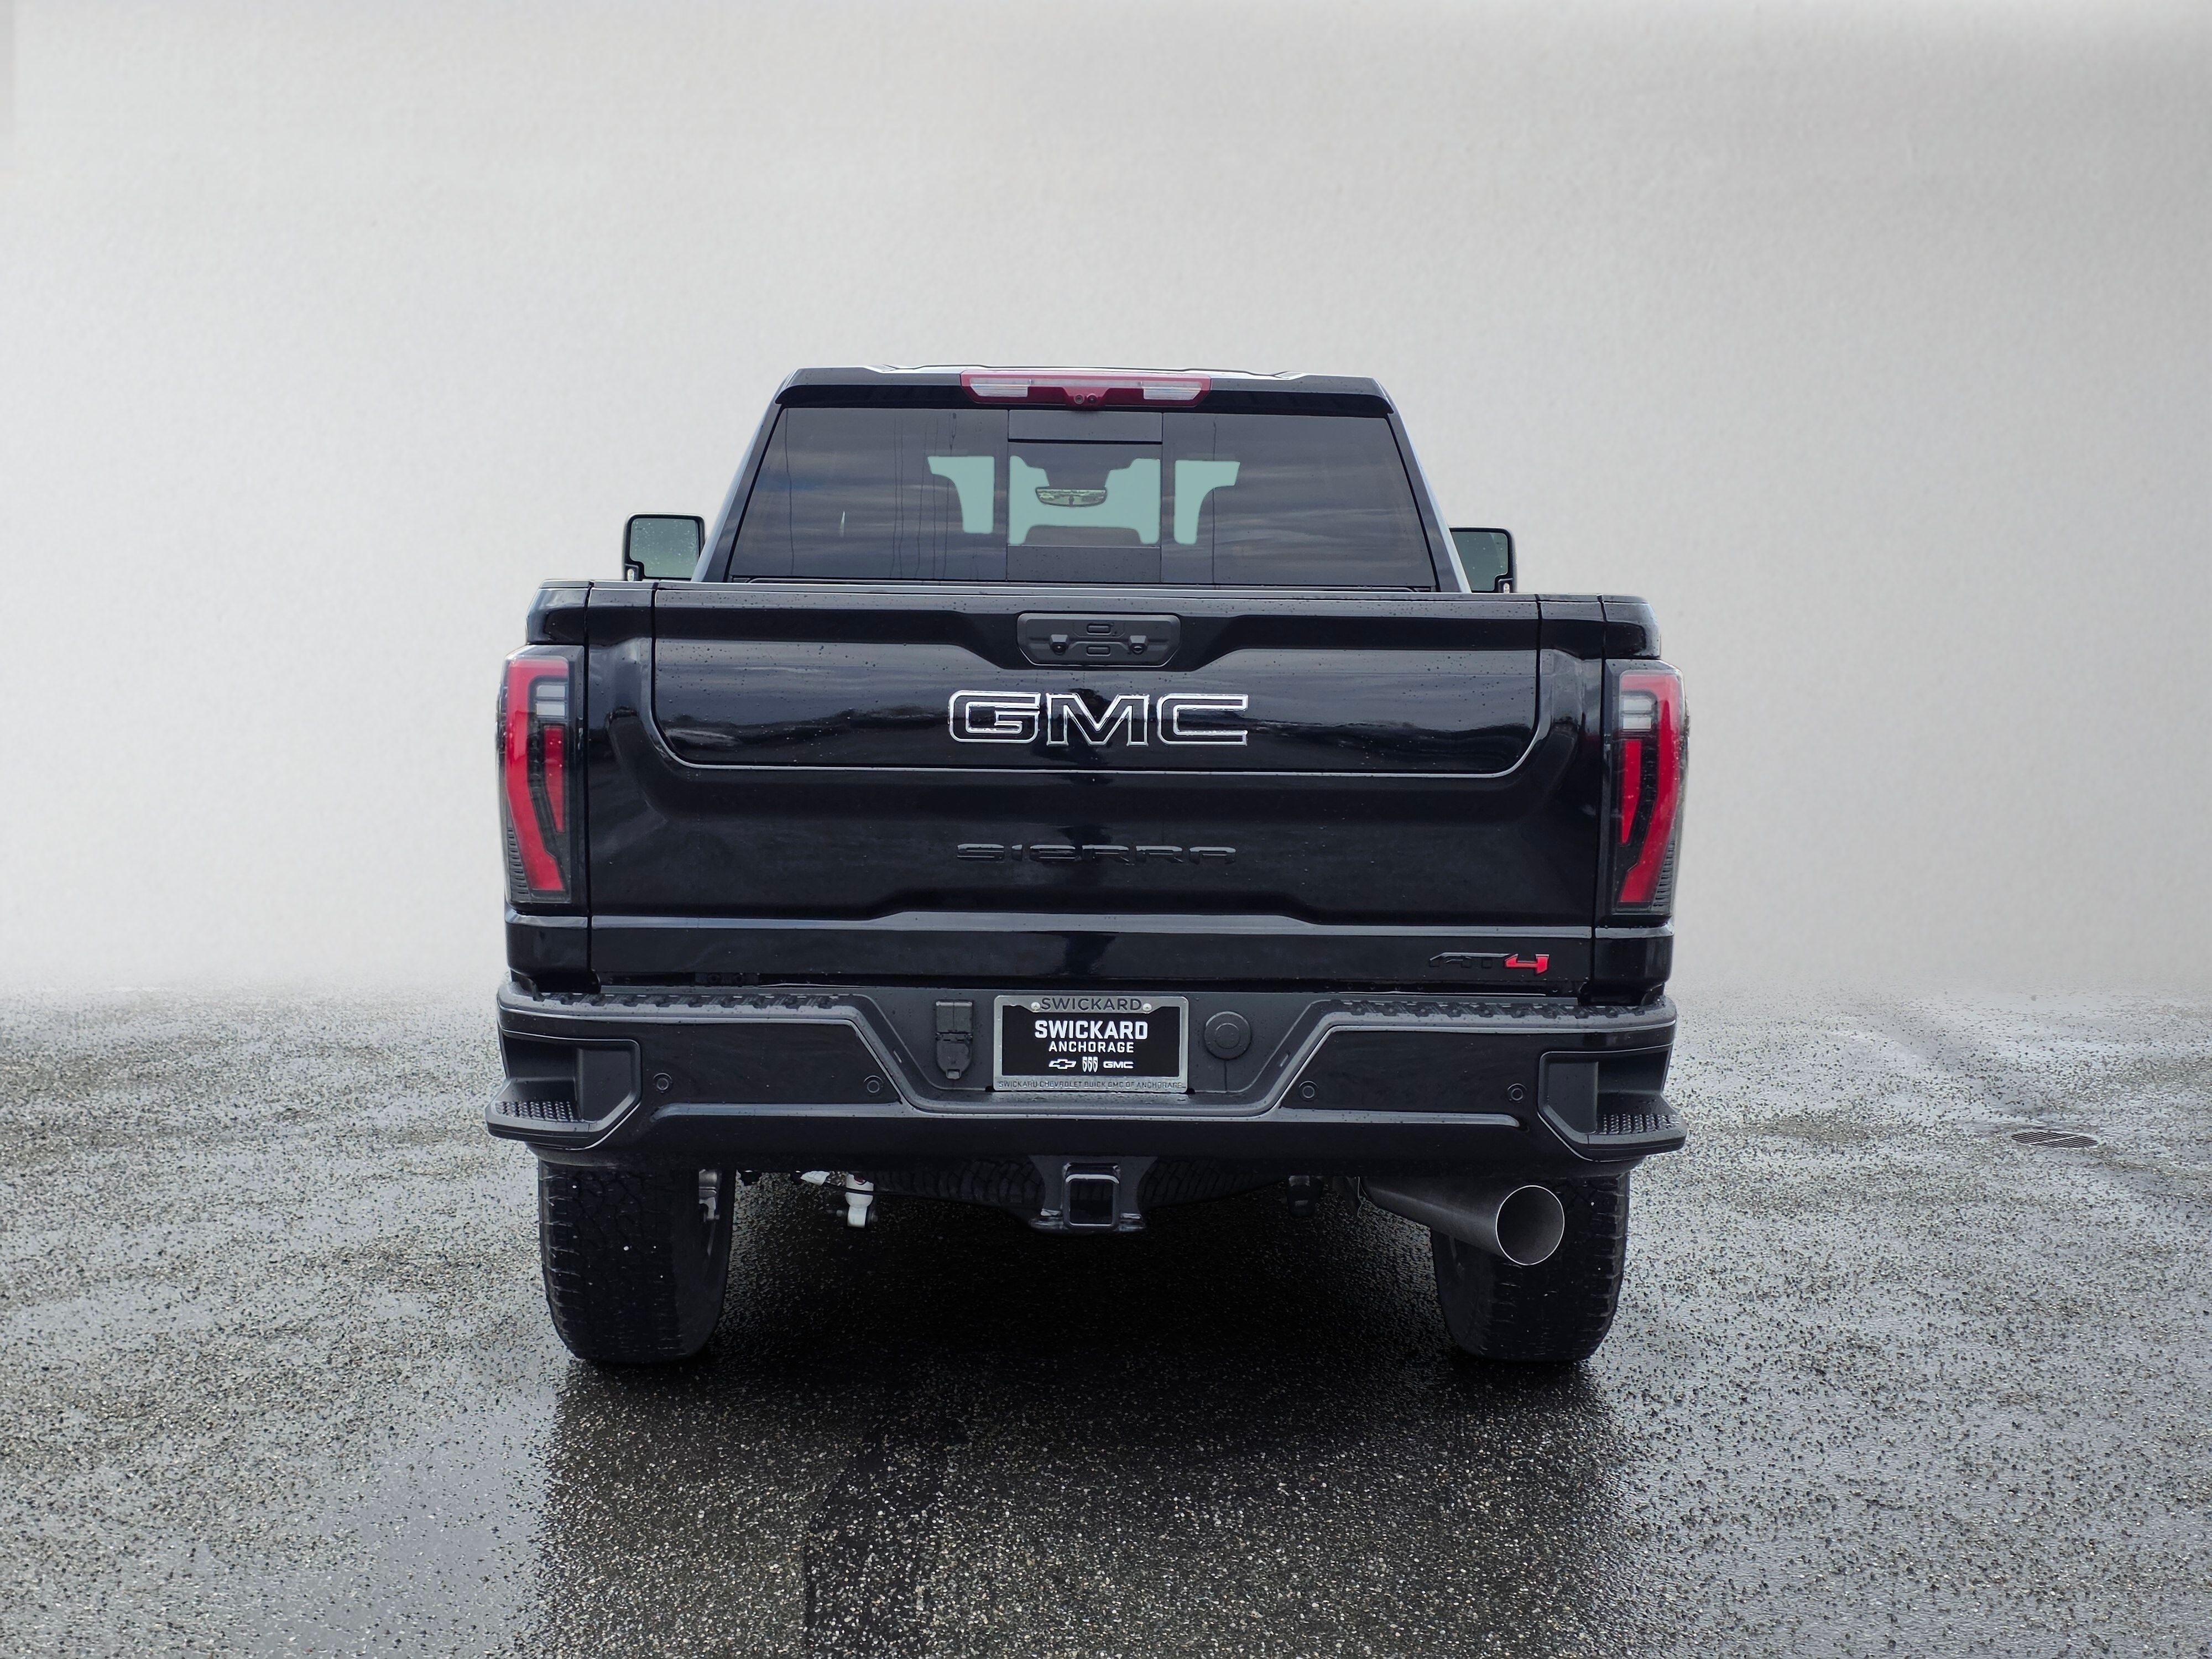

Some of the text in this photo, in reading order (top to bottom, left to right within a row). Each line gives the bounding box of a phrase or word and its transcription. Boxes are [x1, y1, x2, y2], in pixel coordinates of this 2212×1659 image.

[947, 690, 1249, 747] GMC
[956, 843, 1237, 864] SIERRA
[1429, 952, 1550, 975] AT4
[1040, 998, 1142, 1011] SWICKARD
[1035, 1020, 1148, 1040] SWICKARD
[1048, 1041, 1134, 1053] ANCHORAGE
[1103, 1060, 1134, 1069] GMC
[1040, 1081, 1082, 1089] CHEVROLET
